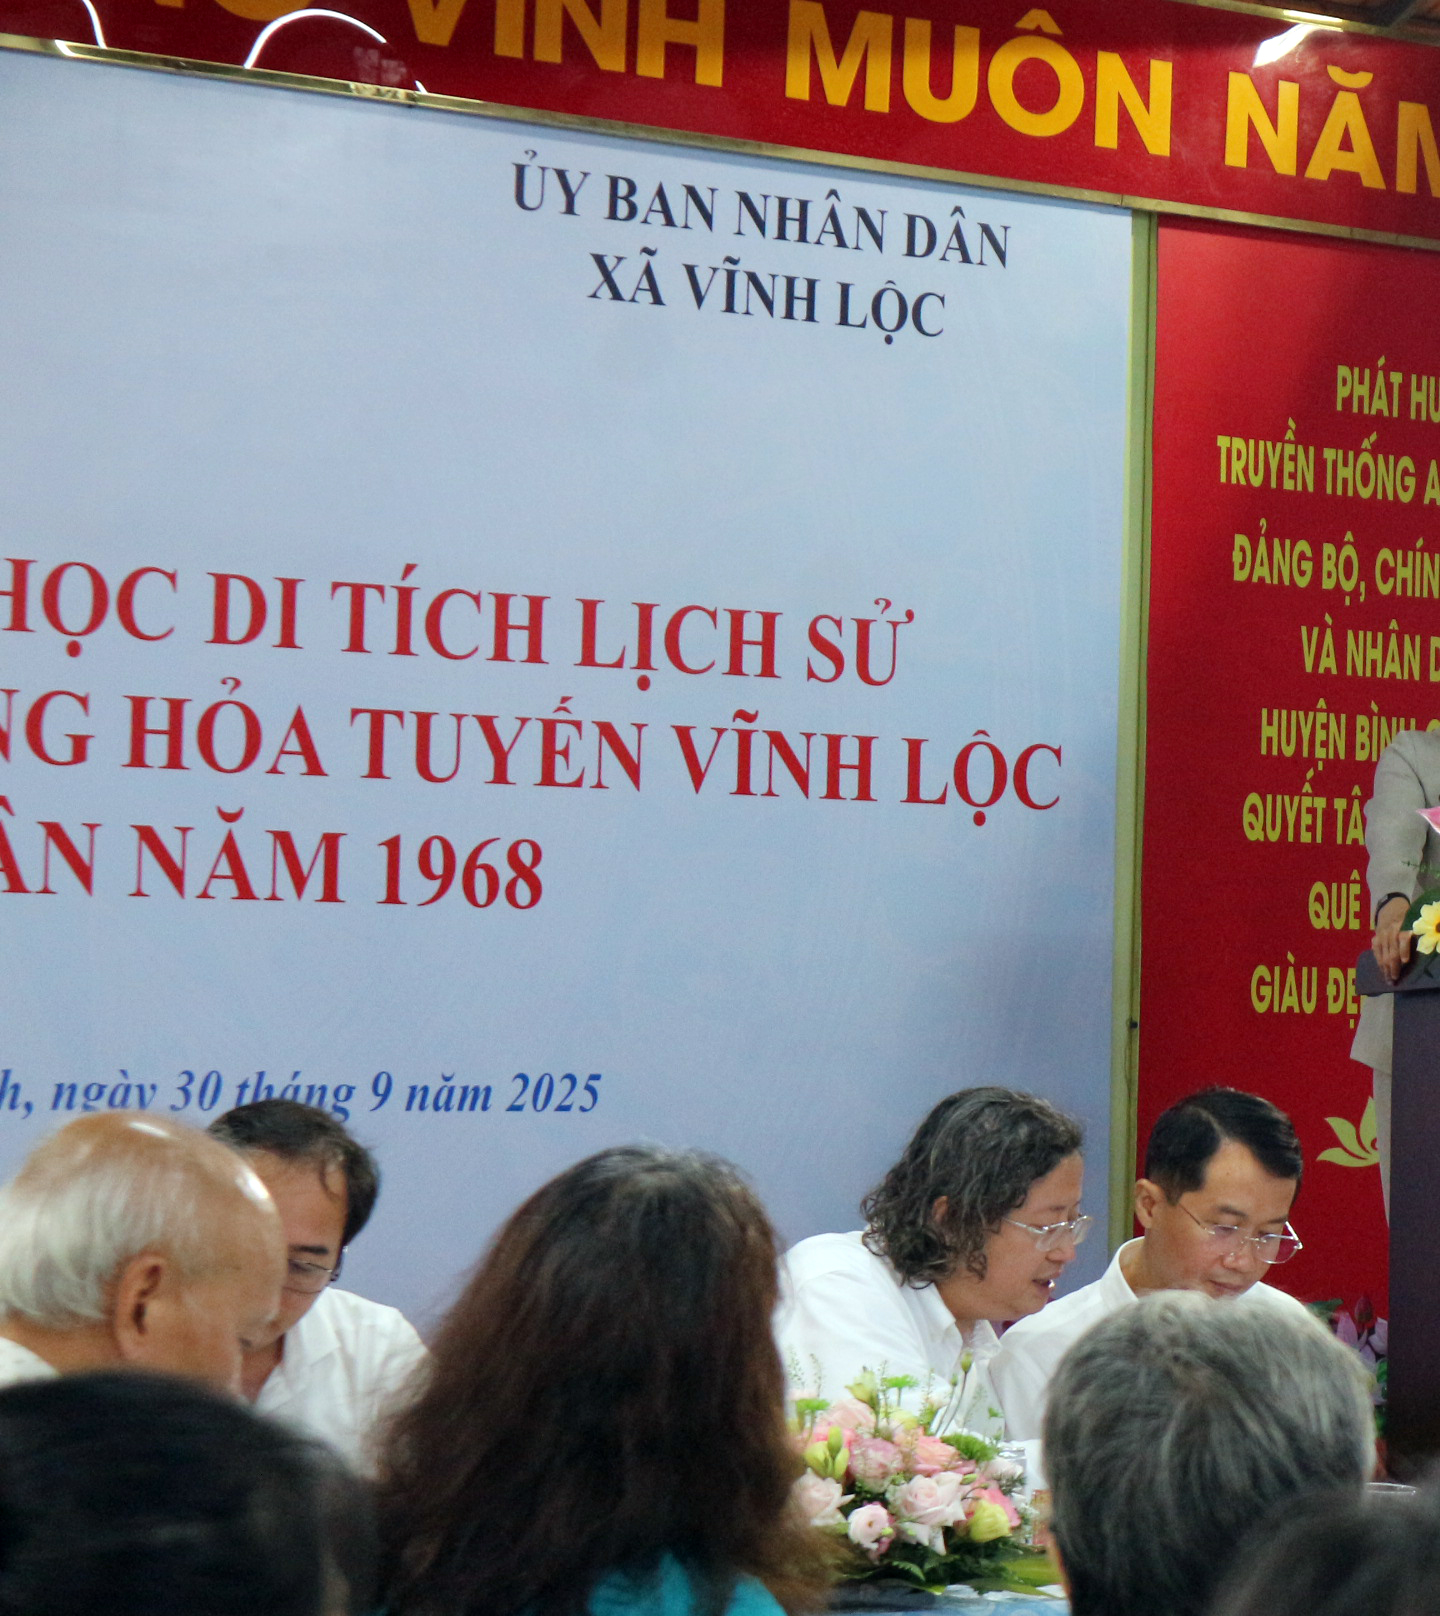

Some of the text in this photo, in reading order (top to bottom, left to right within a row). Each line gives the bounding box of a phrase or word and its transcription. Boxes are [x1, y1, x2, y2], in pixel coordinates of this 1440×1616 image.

[785, 2, 1174, 157] MUÔN
[513, 150, 1011, 269] ỦY BAN NHÂN DÂN
[588, 246, 946, 346] XÃ VĨNH LỘC
[1336, 355, 1403, 418] PHÁT
[1216, 417, 1315, 493] TRUYỀN
[1323, 431, 1417, 504] THỐNG
[1232, 518, 1314, 588] ĐẢNG
[1322, 531, 1366, 606] BỘ,
[205, 572, 306, 649] DI
[331, 563, 552, 665] TÍCH
[574, 597, 784, 692] LỊCH
[806, 597, 915, 687] SỬ
[1301, 613, 1338, 675] VÀ
[1346, 619, 1421, 682] NHÂN
[121, 676, 330, 778] HỎA
[350, 695, 650, 793] TUYẾN
[670, 708, 880, 804] VĨNH
[900, 729, 1063, 828] LỘC
[1260, 698, 1416, 771] HUYỆN BÌN
[1242, 768, 1365, 845] QUYẾT TÂ
[128, 805, 349, 904] NĂM
[377, 833, 544, 911] 1968
[1308, 869, 1361, 931] QUÊ
[1250, 951, 1366, 1029] GIÀU ĐẸ
[169, 1069, 223, 1112] 30
[234, 1070, 357, 1123] tháng
[369, 1071, 394, 1112] 9
[404, 1073, 493, 1113] năm
[505, 1073, 602, 1114] 2025
